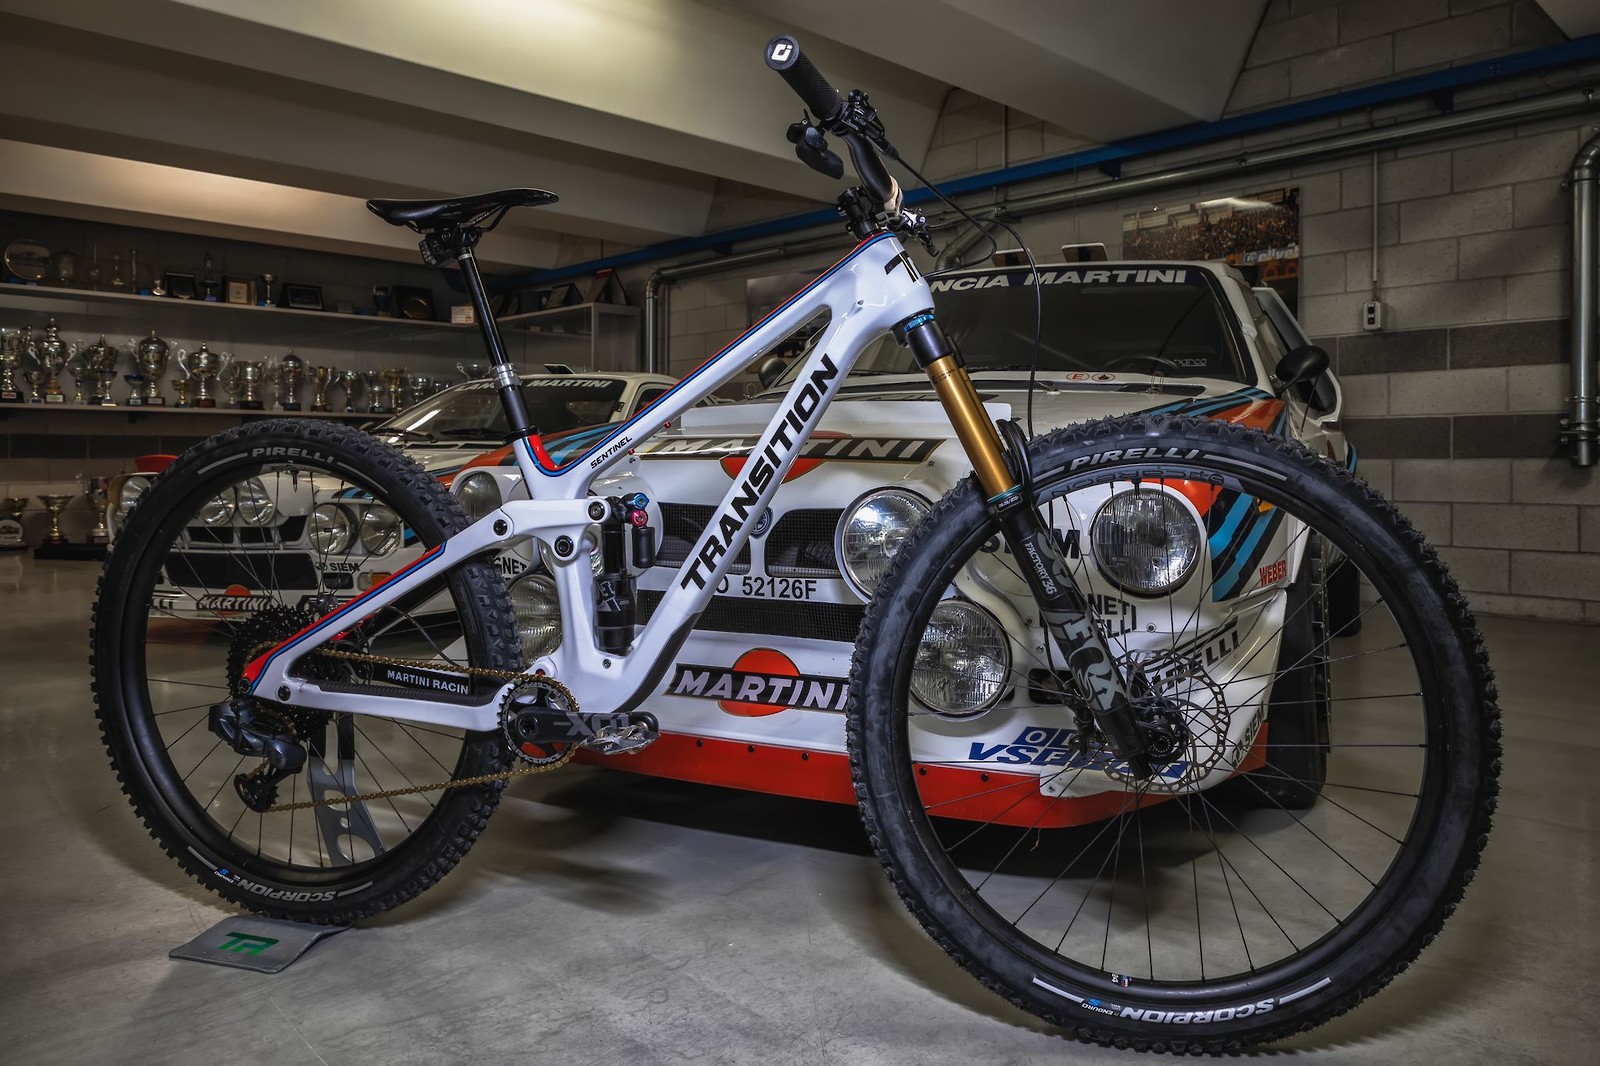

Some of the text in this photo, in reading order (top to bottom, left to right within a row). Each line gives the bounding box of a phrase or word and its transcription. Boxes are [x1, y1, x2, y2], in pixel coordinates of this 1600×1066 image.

[929, 269, 1186, 293] NCIA MARTINI
[526, 379, 613, 389] MARTINI
[251, 446, 335, 465] PIRELLI
[590, 435, 633, 469] SENTINEL
[662, 438, 926, 458] MATINI
[1069, 447, 1200, 471] PIRELLI
[680, 352, 839, 592] TRANSITION
[329, 562, 360, 572] SIEM
[1024, 542, 1058, 595] FACTORY 36
[1258, 559, 1288, 587] WEBER
[715, 576, 818, 600] O 52126F
[1087, 593, 1136, 630] NETI
[387, 669, 470, 695] MARTINI RACIN
[673, 669, 849, 711] MARTINI
[237, 878, 338, 902] SCORPION
[1082, 996, 1276, 1025] SCORPION ENDURO
